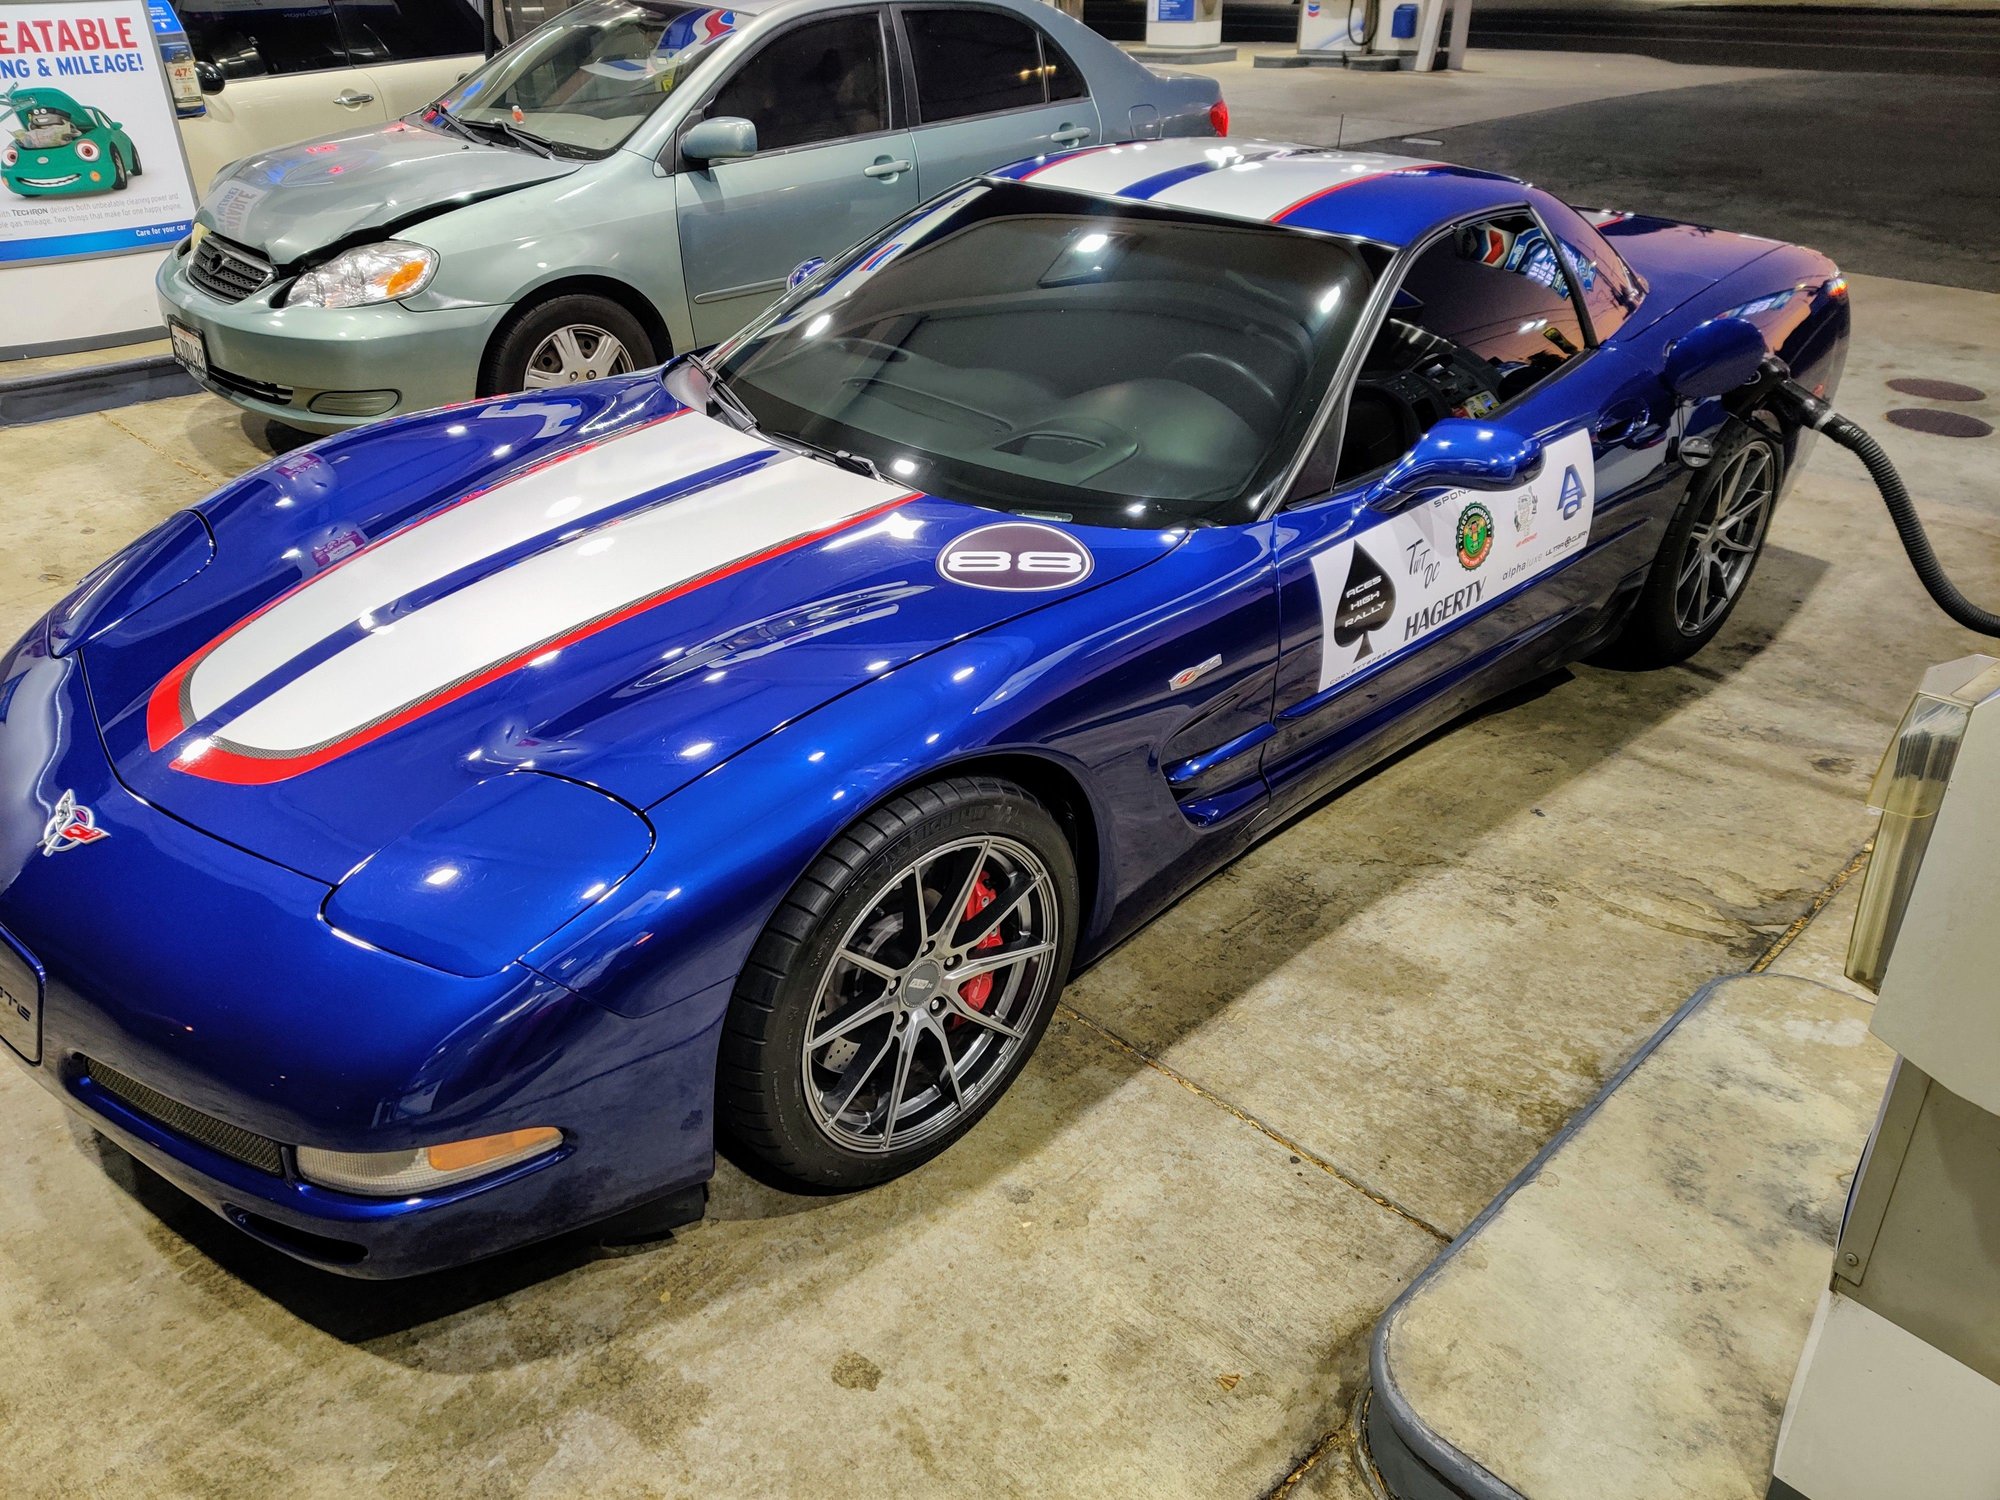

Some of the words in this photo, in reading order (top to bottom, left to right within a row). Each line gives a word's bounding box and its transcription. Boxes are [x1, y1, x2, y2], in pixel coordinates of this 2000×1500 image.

[0, 17, 138, 54] EATABLE
[0, 59, 30, 79] NG
[36, 57, 52, 77] &
[55, 53, 144, 76] MILEAGE!
[11, 208, 48, 216] TECHRON
[54, 215, 67, 223] Two
[135, 229, 150, 237] Care
[151, 227, 161, 235] for
[162, 225, 175, 235] your
[947, 551, 1083, 572] 88
[1346, 575, 1382, 598] ACES
[1350, 590, 1380, 611] HIGH
[1404, 576, 1487, 642] HAGERTY
[1344, 600, 1386, 628] RALLY
